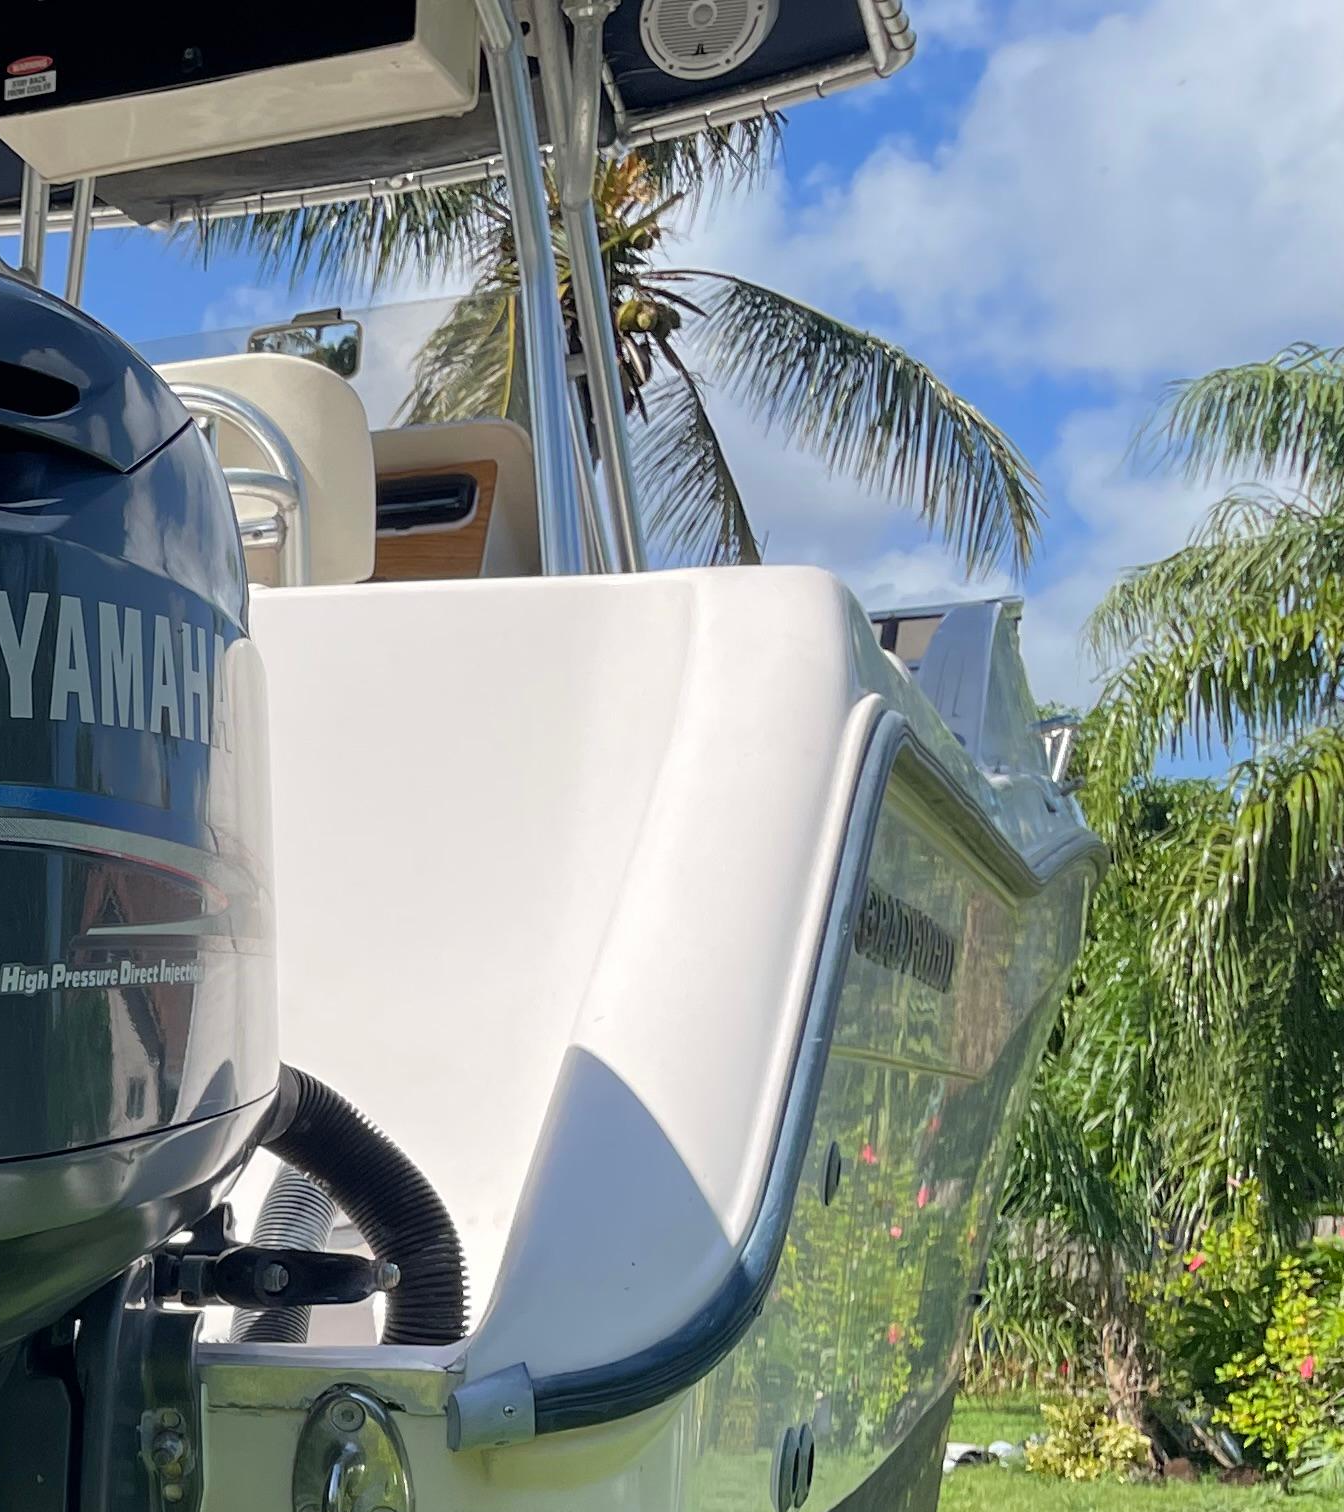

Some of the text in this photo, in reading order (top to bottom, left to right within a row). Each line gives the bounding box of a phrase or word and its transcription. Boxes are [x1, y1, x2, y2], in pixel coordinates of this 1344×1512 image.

[1, 965, 49, 994] High
[51, 963, 118, 988] Pressure
[119, 960, 159, 984] Direct
